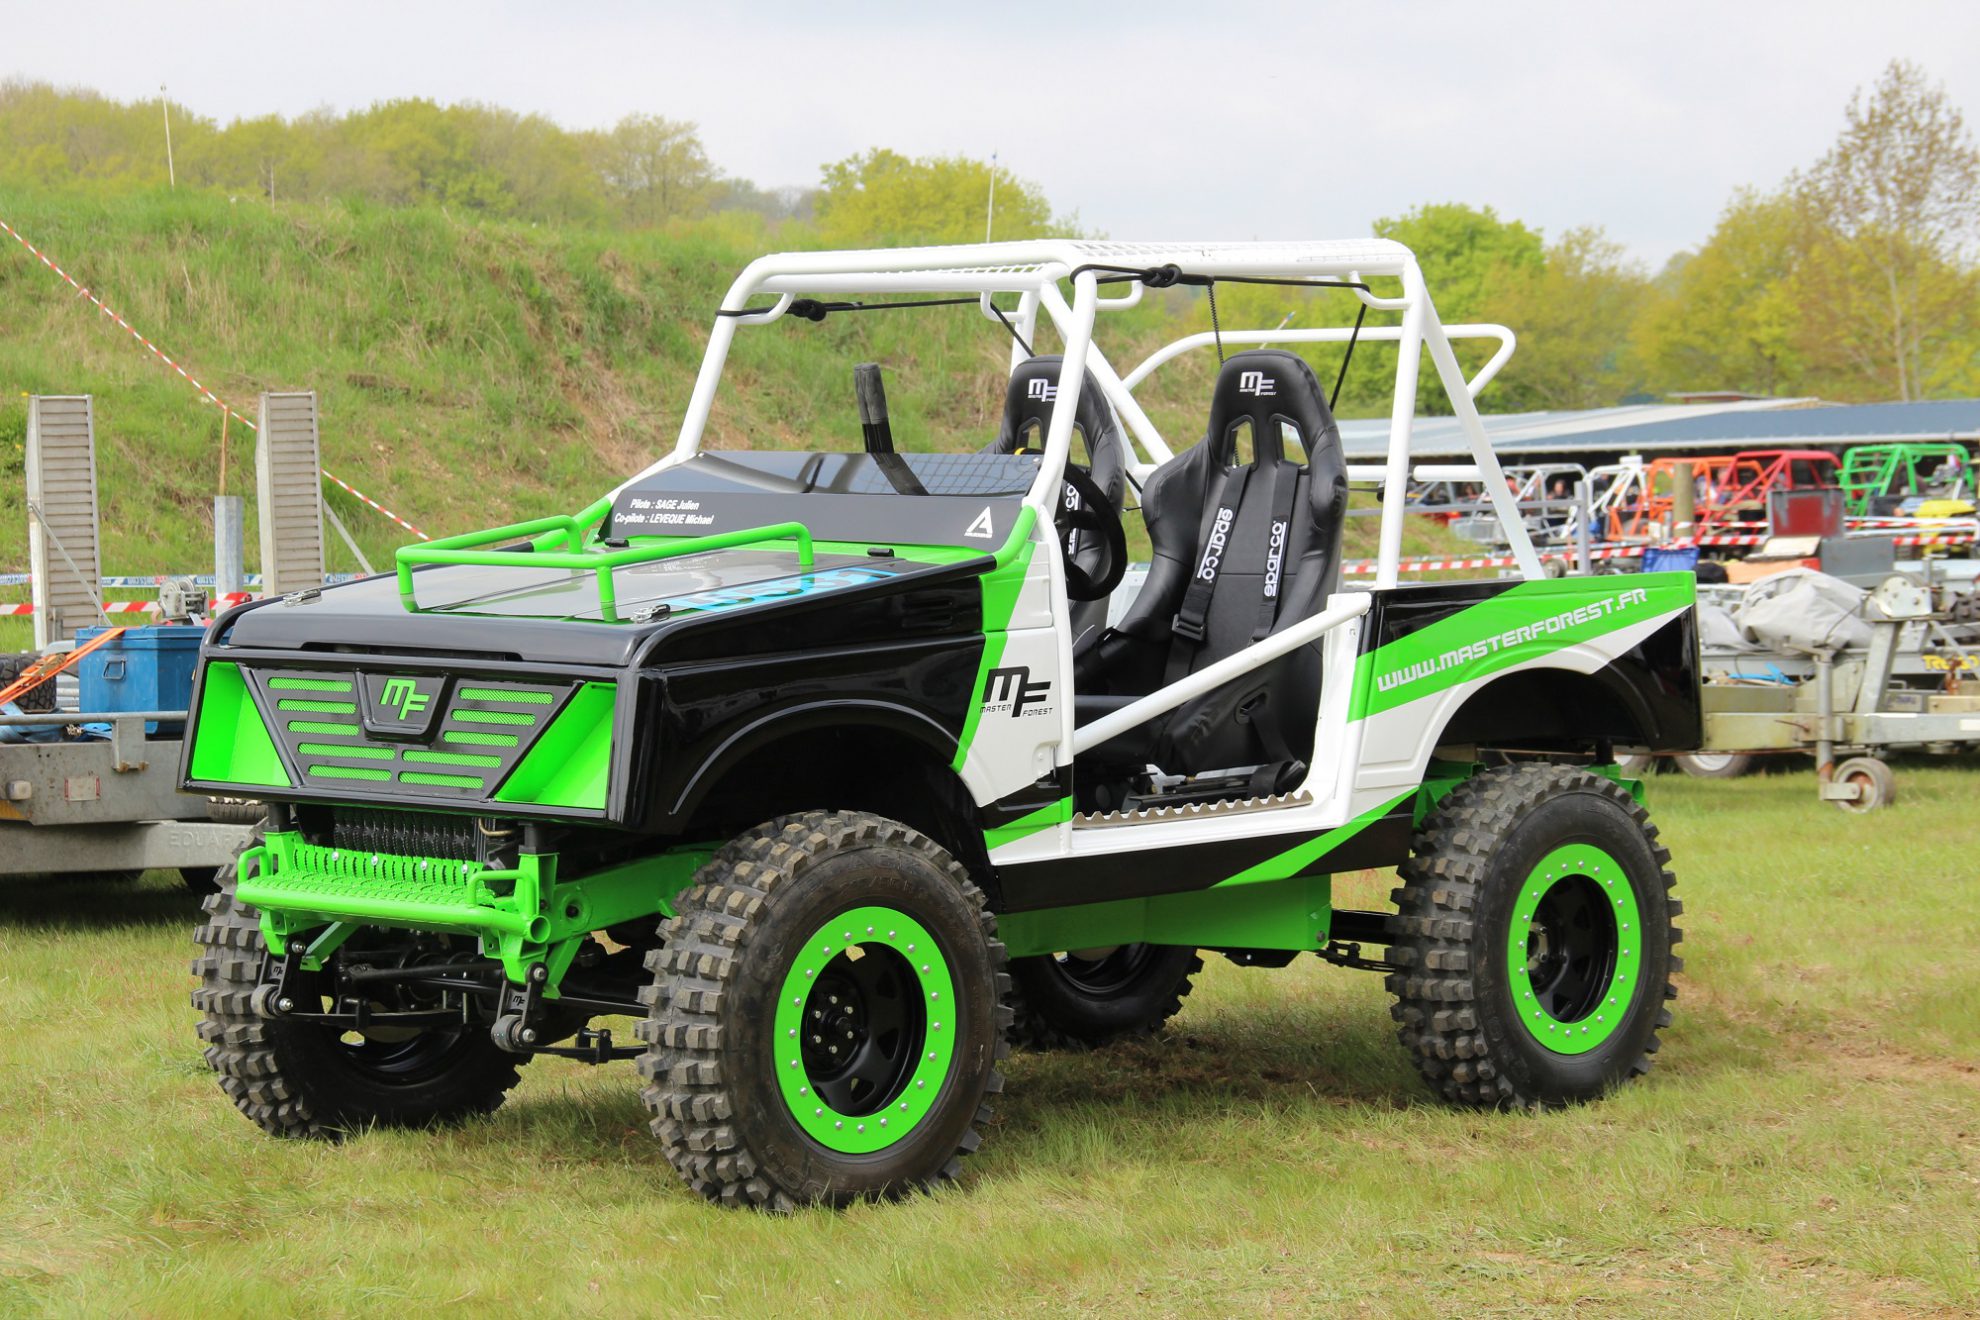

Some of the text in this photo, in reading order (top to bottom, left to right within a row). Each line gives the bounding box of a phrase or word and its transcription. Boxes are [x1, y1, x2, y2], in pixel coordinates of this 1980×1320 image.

[1240, 371, 1275, 396] MF
[649, 513, 686, 525] LEVEQUE
[655, 499, 678, 510] SAGE
[1197, 507, 1233, 582] sparco
[1263, 521, 1287, 597] sparco
[1377, 588, 1648, 693] WWW.MASTERFOREST.FR
[379, 677, 431, 720] MF
[980, 703, 1012, 714] MASTER
[982, 666, 1051, 718] MF
[1022, 707, 1054, 717] FOREST
